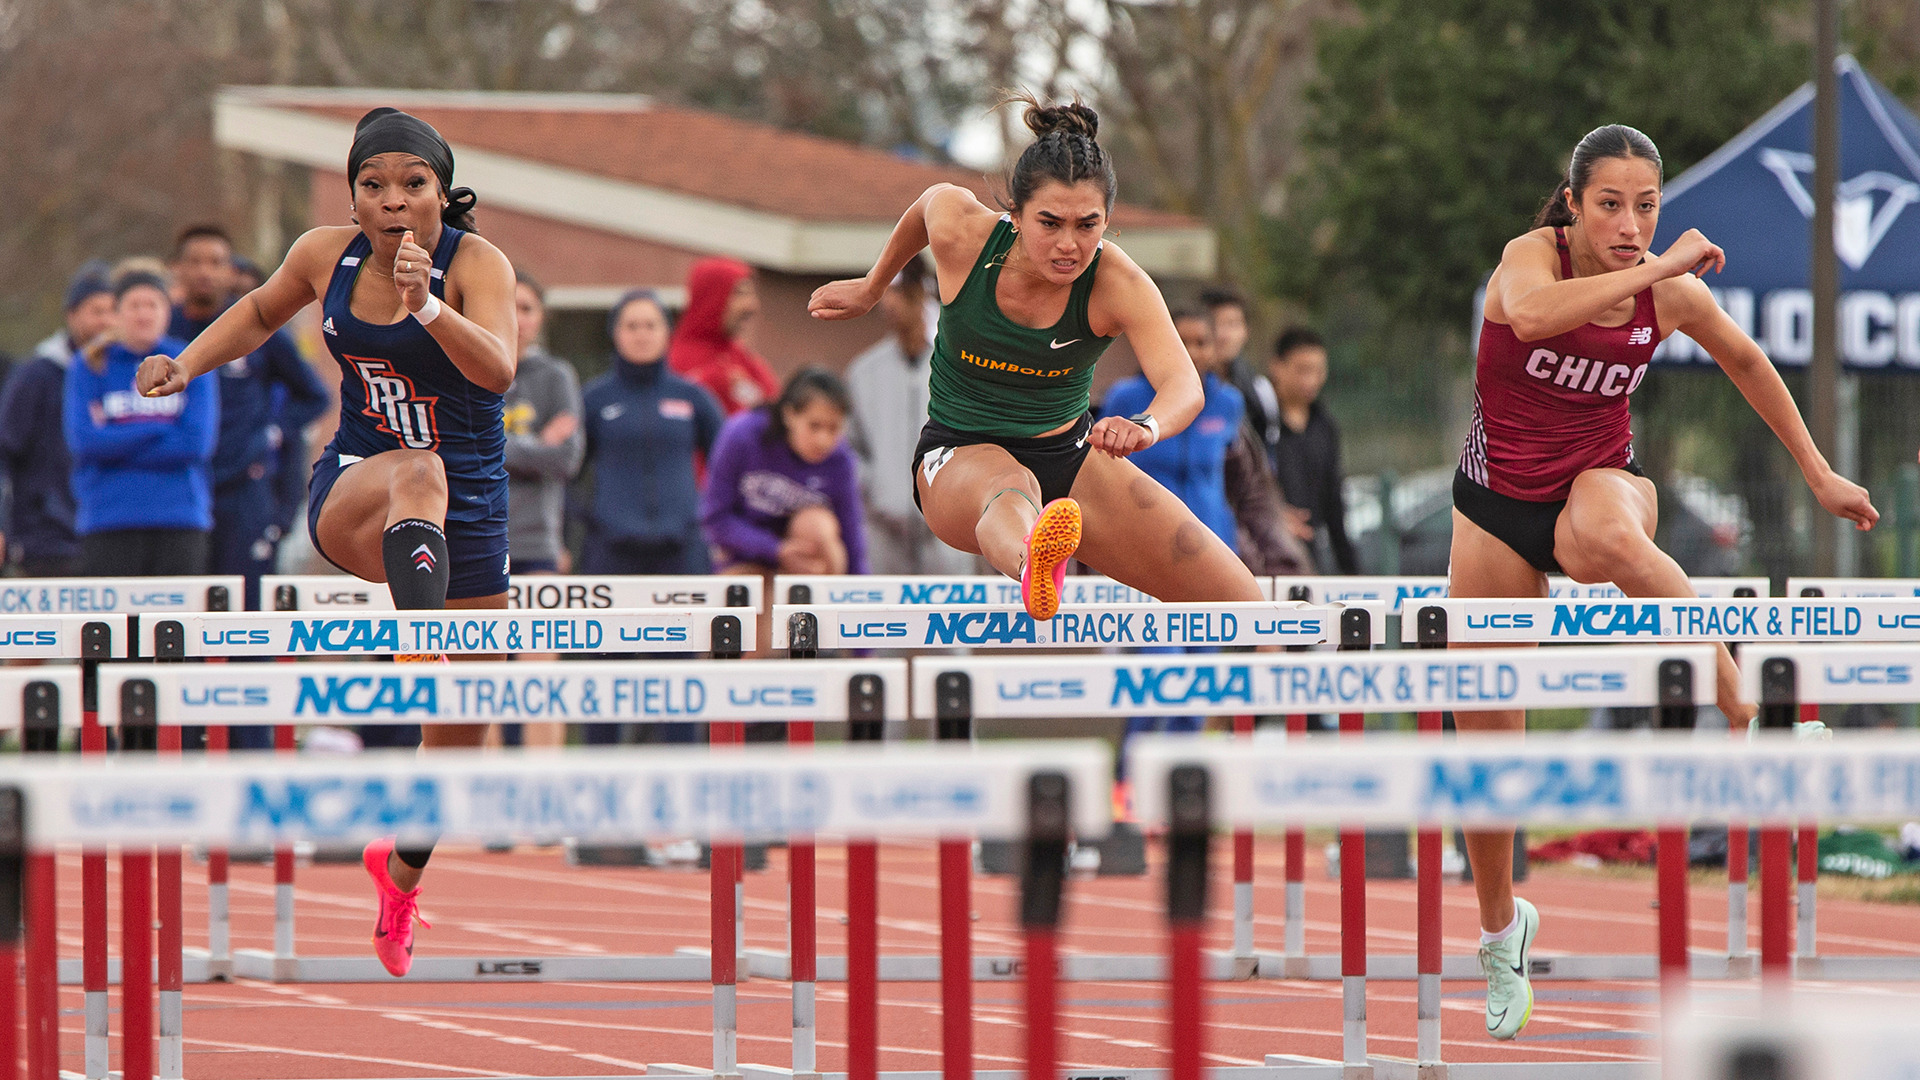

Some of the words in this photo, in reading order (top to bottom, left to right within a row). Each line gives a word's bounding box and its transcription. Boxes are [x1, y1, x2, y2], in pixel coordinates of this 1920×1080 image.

[960, 349, 1074, 377] HUMBOLDT
[1525, 348, 1648, 397] CHICO
[356, 362, 433, 448] FPU
[39, 588, 53, 612] &
[59, 587, 118, 612] FIELD
[131, 592, 185, 606] UCS
[314, 592, 370, 605] UCS
[653, 593, 707, 605] UCS
[829, 591, 884, 603] UCS
[900, 584, 987, 604] NCAA
[202, 630, 271, 646] UCS
[287, 620, 399, 652] NCAA
[410, 621, 499, 650] TRACK
[507, 620, 523, 650] &
[531, 620, 603, 649] FIELD
[620, 626, 687, 642] UCS
[840, 622, 907, 638] UCS
[925, 612, 1036, 644] NCAA
[1050, 613, 1135, 643] TRACK
[1142, 613, 1159, 642] &
[1167, 613, 1238, 642] FIELD
[1255, 619, 1321, 635] UCS
[1467, 613, 1533, 629] UCS
[1550, 604, 1661, 636] NCAA
[1672, 606, 1759, 636] TRACK
[1766, 606, 1783, 636] &
[1791, 607, 1861, 636] FIELD
[998, 679, 1085, 701] UCS
[1110, 667, 1252, 706] NCAA
[1269, 665, 1382, 703] TRACK
[1394, 665, 1413, 702] &
[1426, 664, 1518, 701] FIELD
[1540, 672, 1626, 692] UCS
[1826, 664, 1911, 685] UCS
[182, 686, 270, 706] UCS
[294, 677, 438, 715] NCAA
[455, 678, 568, 716] TRACK
[580, 678, 600, 715] &
[613, 678, 707, 716] FIELD
[728, 687, 816, 706] UCS
[1423, 757, 1625, 816] NCAA
[240, 778, 443, 837] NCAA
[476, 961, 542, 976] UCS
